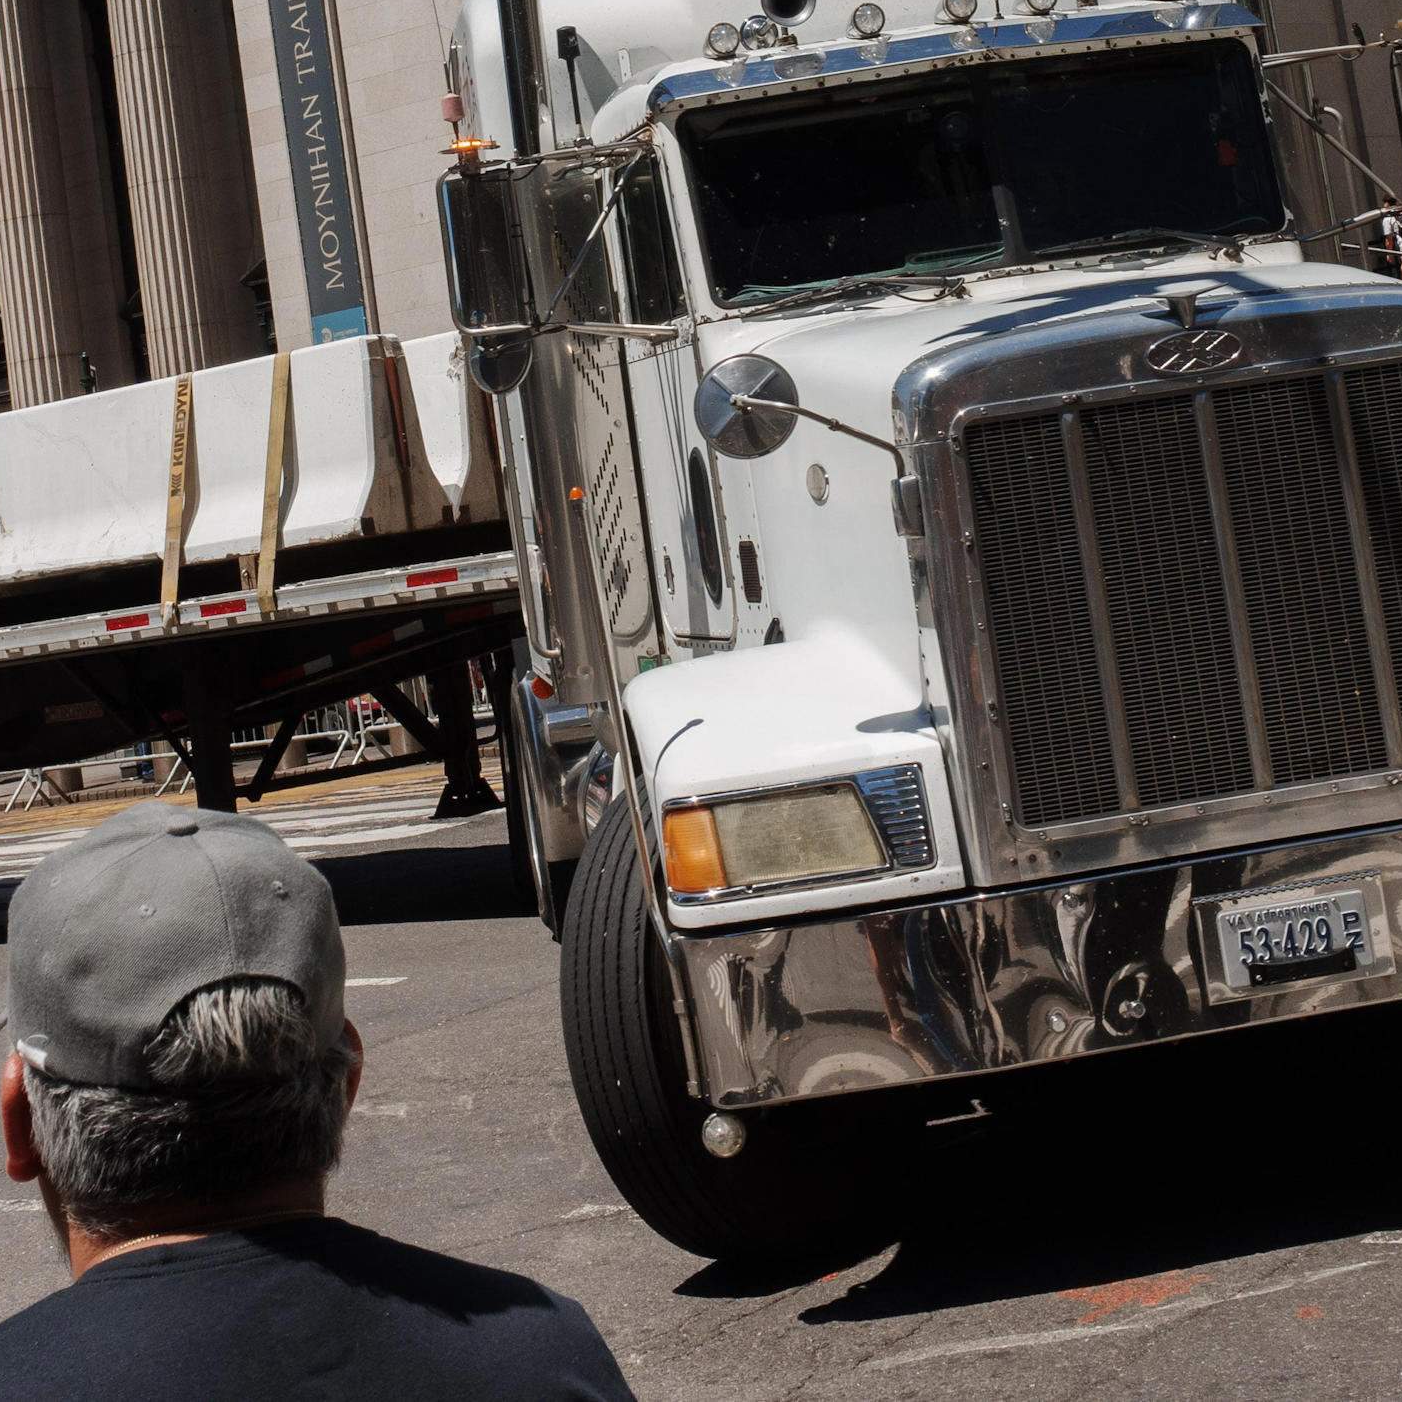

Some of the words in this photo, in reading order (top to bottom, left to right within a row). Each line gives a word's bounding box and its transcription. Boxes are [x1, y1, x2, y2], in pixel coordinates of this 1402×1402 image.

[300, 94, 345, 290] MOYNIHAN
[1226, 915, 1245, 929] VA
[1254, 900, 1330, 924] APPORTIONED
[1238, 916, 1335, 966] 53-429
